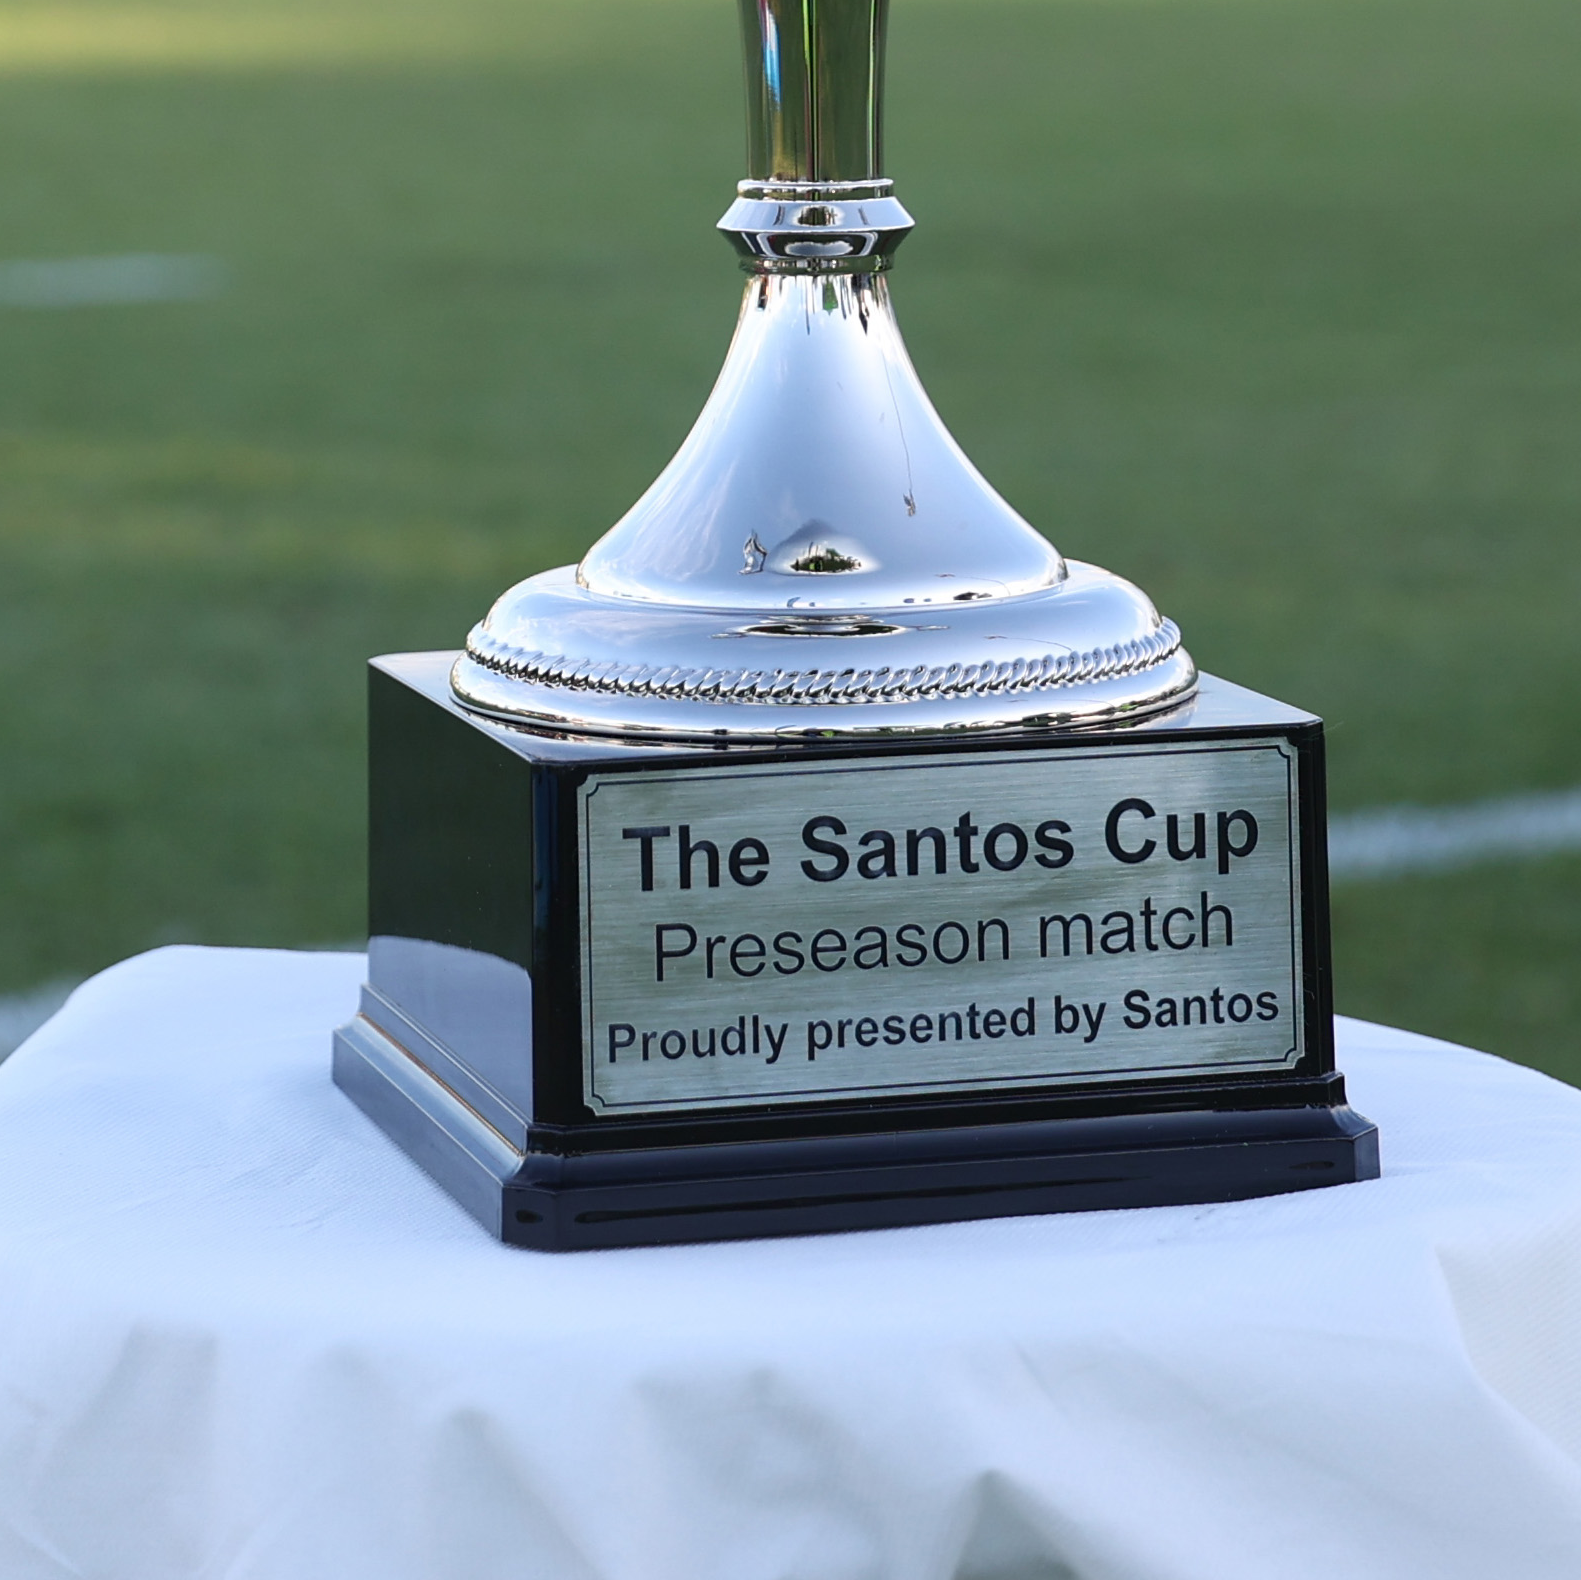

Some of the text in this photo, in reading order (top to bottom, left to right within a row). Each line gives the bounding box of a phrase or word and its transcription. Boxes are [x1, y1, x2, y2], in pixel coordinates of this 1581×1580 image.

[620, 797, 1260, 893] The Santos Cup
[654, 890, 1234, 983] Preseason match
[607, 987, 1281, 1065] Proudly presented by Santos
